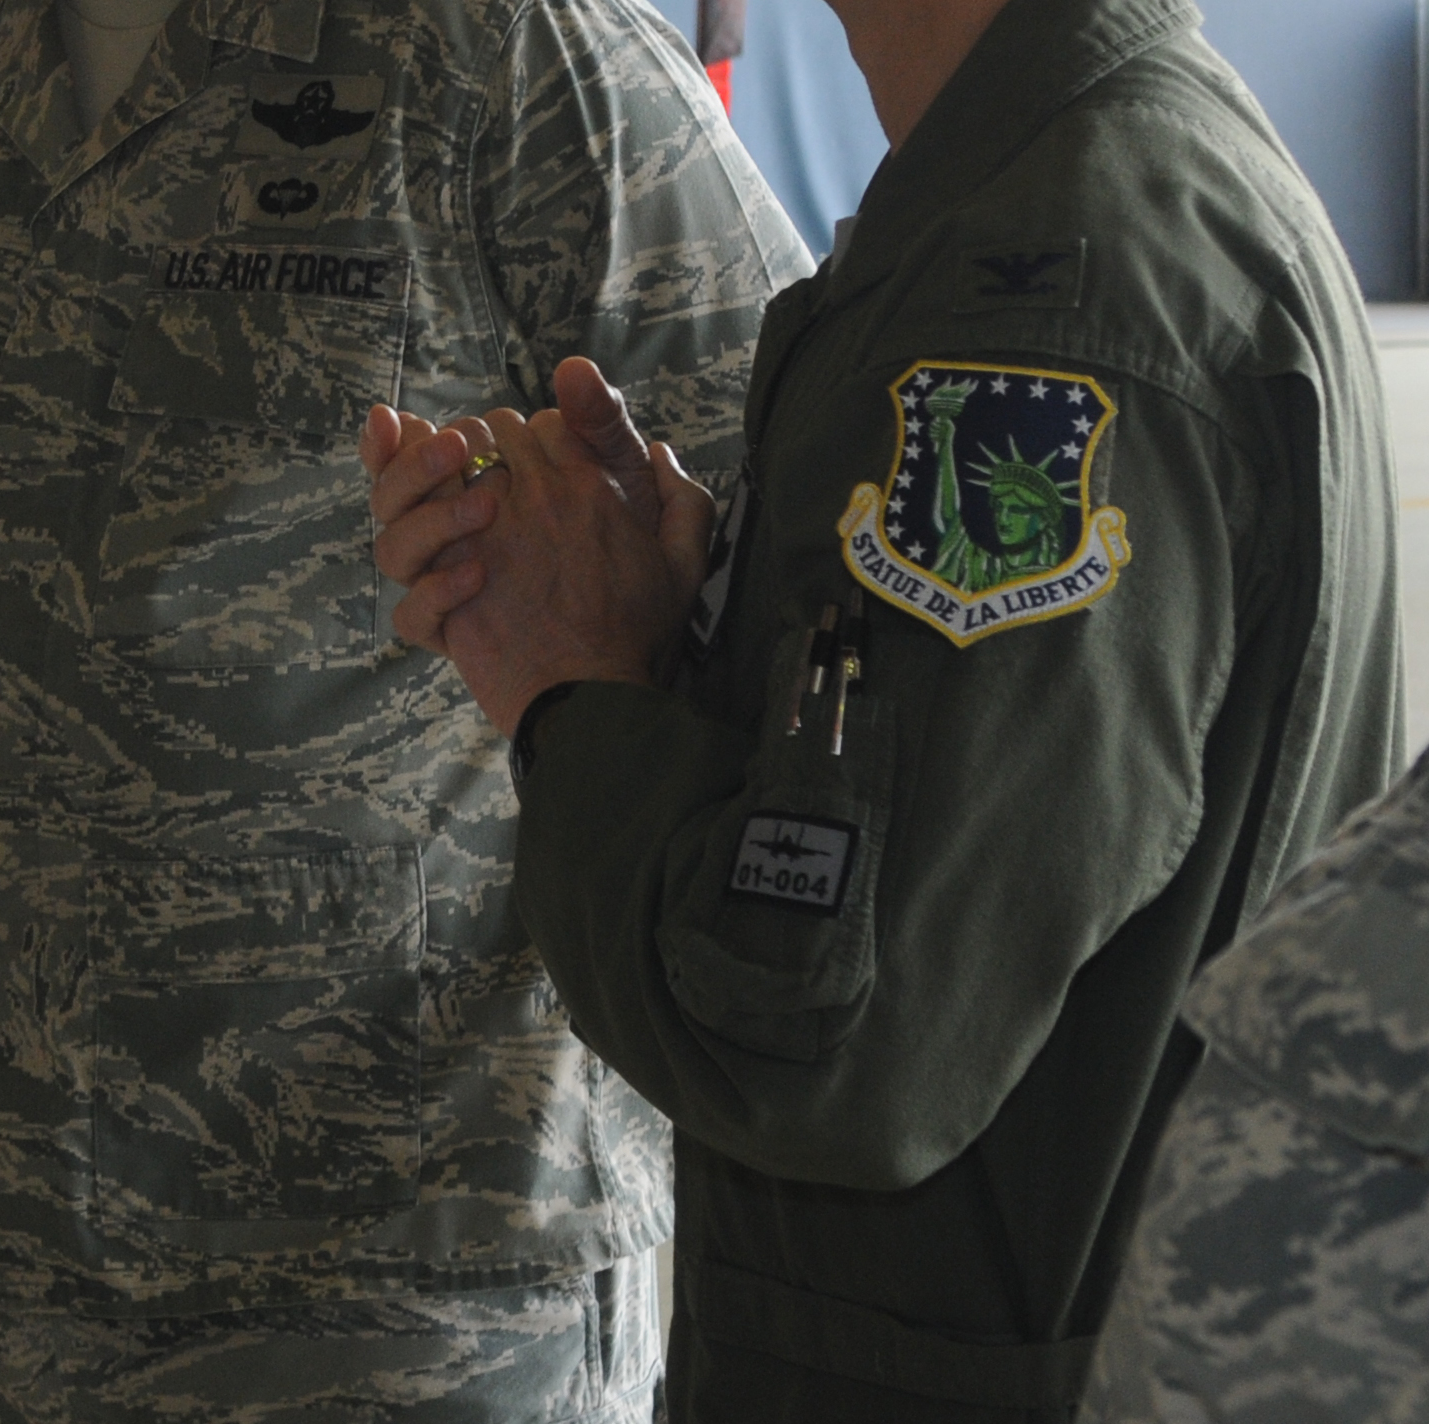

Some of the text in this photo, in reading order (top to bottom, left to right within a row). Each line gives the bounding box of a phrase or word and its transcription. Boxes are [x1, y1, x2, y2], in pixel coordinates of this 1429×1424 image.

[217, 250, 272, 291] AIR
[275, 253, 389, 299] FORCE
[852, 532, 1108, 631] STATUE DE LA LIBERTE
[737, 863, 829, 900] 01-004
